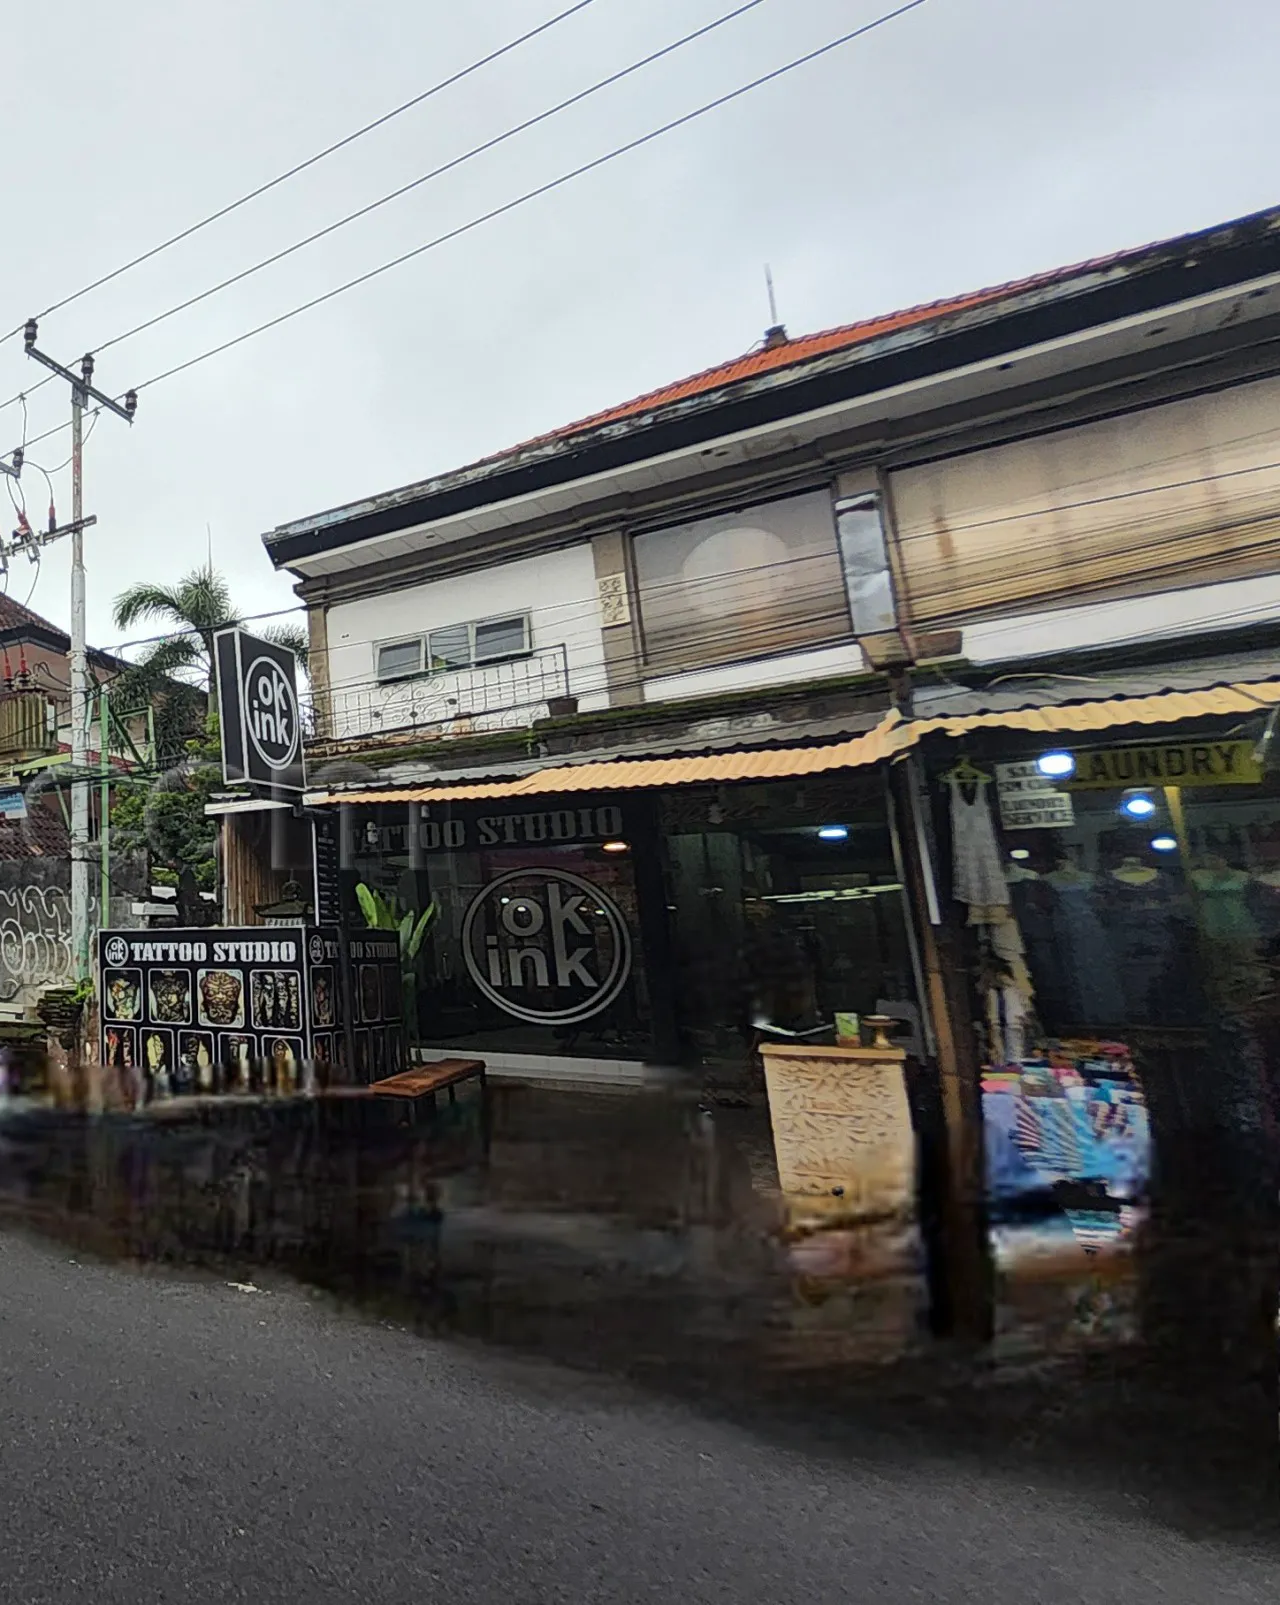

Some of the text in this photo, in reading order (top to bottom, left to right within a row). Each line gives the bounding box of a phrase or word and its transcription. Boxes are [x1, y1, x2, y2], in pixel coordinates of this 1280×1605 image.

[258, 670, 288, 711] ok
[252, 700, 291, 746] ink
[477, 806, 623, 845] STUDIO
[502, 883, 592, 937] ok
[130, 942, 207, 962] TATTOO
[213, 941, 296, 963] STUDIO
[486, 935, 599, 988] ink
